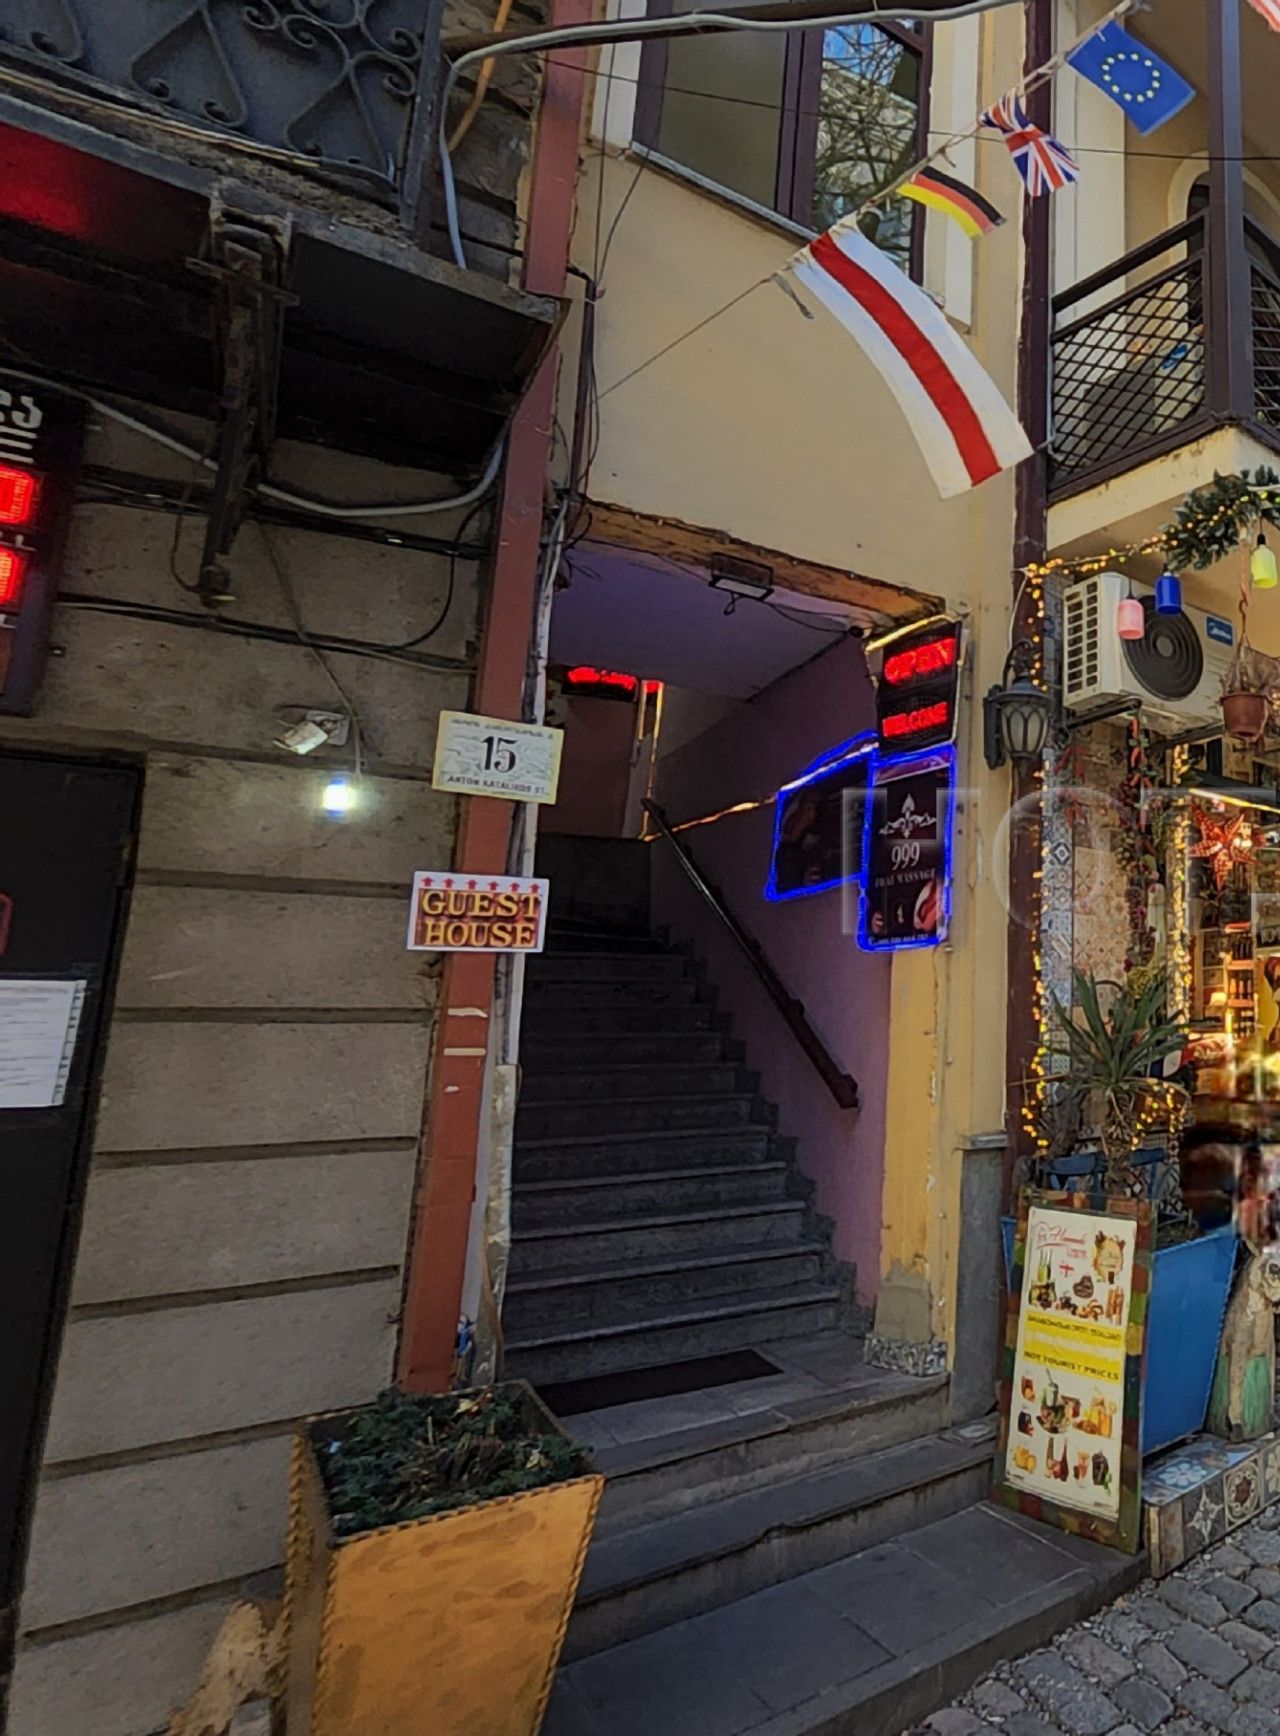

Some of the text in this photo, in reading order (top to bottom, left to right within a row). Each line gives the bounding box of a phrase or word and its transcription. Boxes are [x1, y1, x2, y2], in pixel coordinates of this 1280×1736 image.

[482, 736, 517, 773] 15
[892, 842, 920, 871] 999
[422, 890, 542, 917] GUEST
[424, 919, 536, 948] HOUSE
